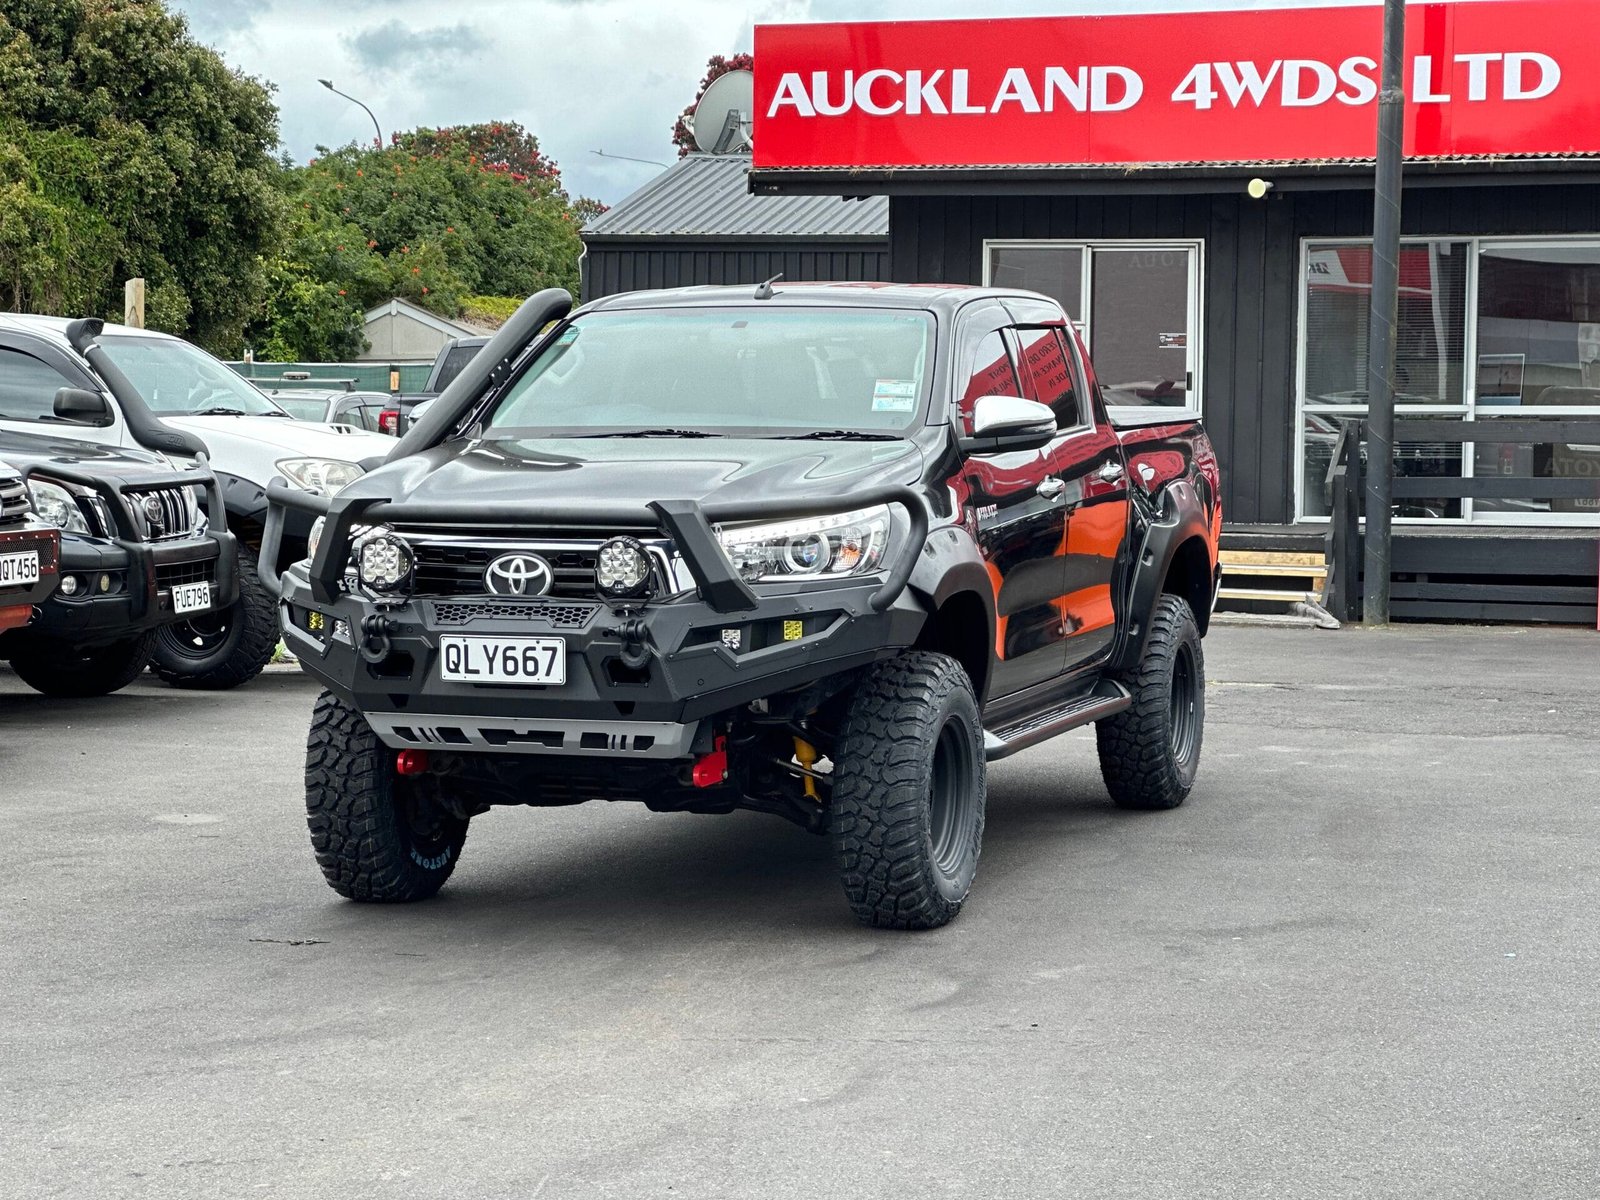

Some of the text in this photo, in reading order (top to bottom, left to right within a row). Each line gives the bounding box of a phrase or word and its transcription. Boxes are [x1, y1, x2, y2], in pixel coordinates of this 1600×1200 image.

[766, 52, 1562, 118] AUCKLAND 4WDS LTD
[175, 586, 209, 609] FUE796
[445, 643, 558, 677] QLY667
